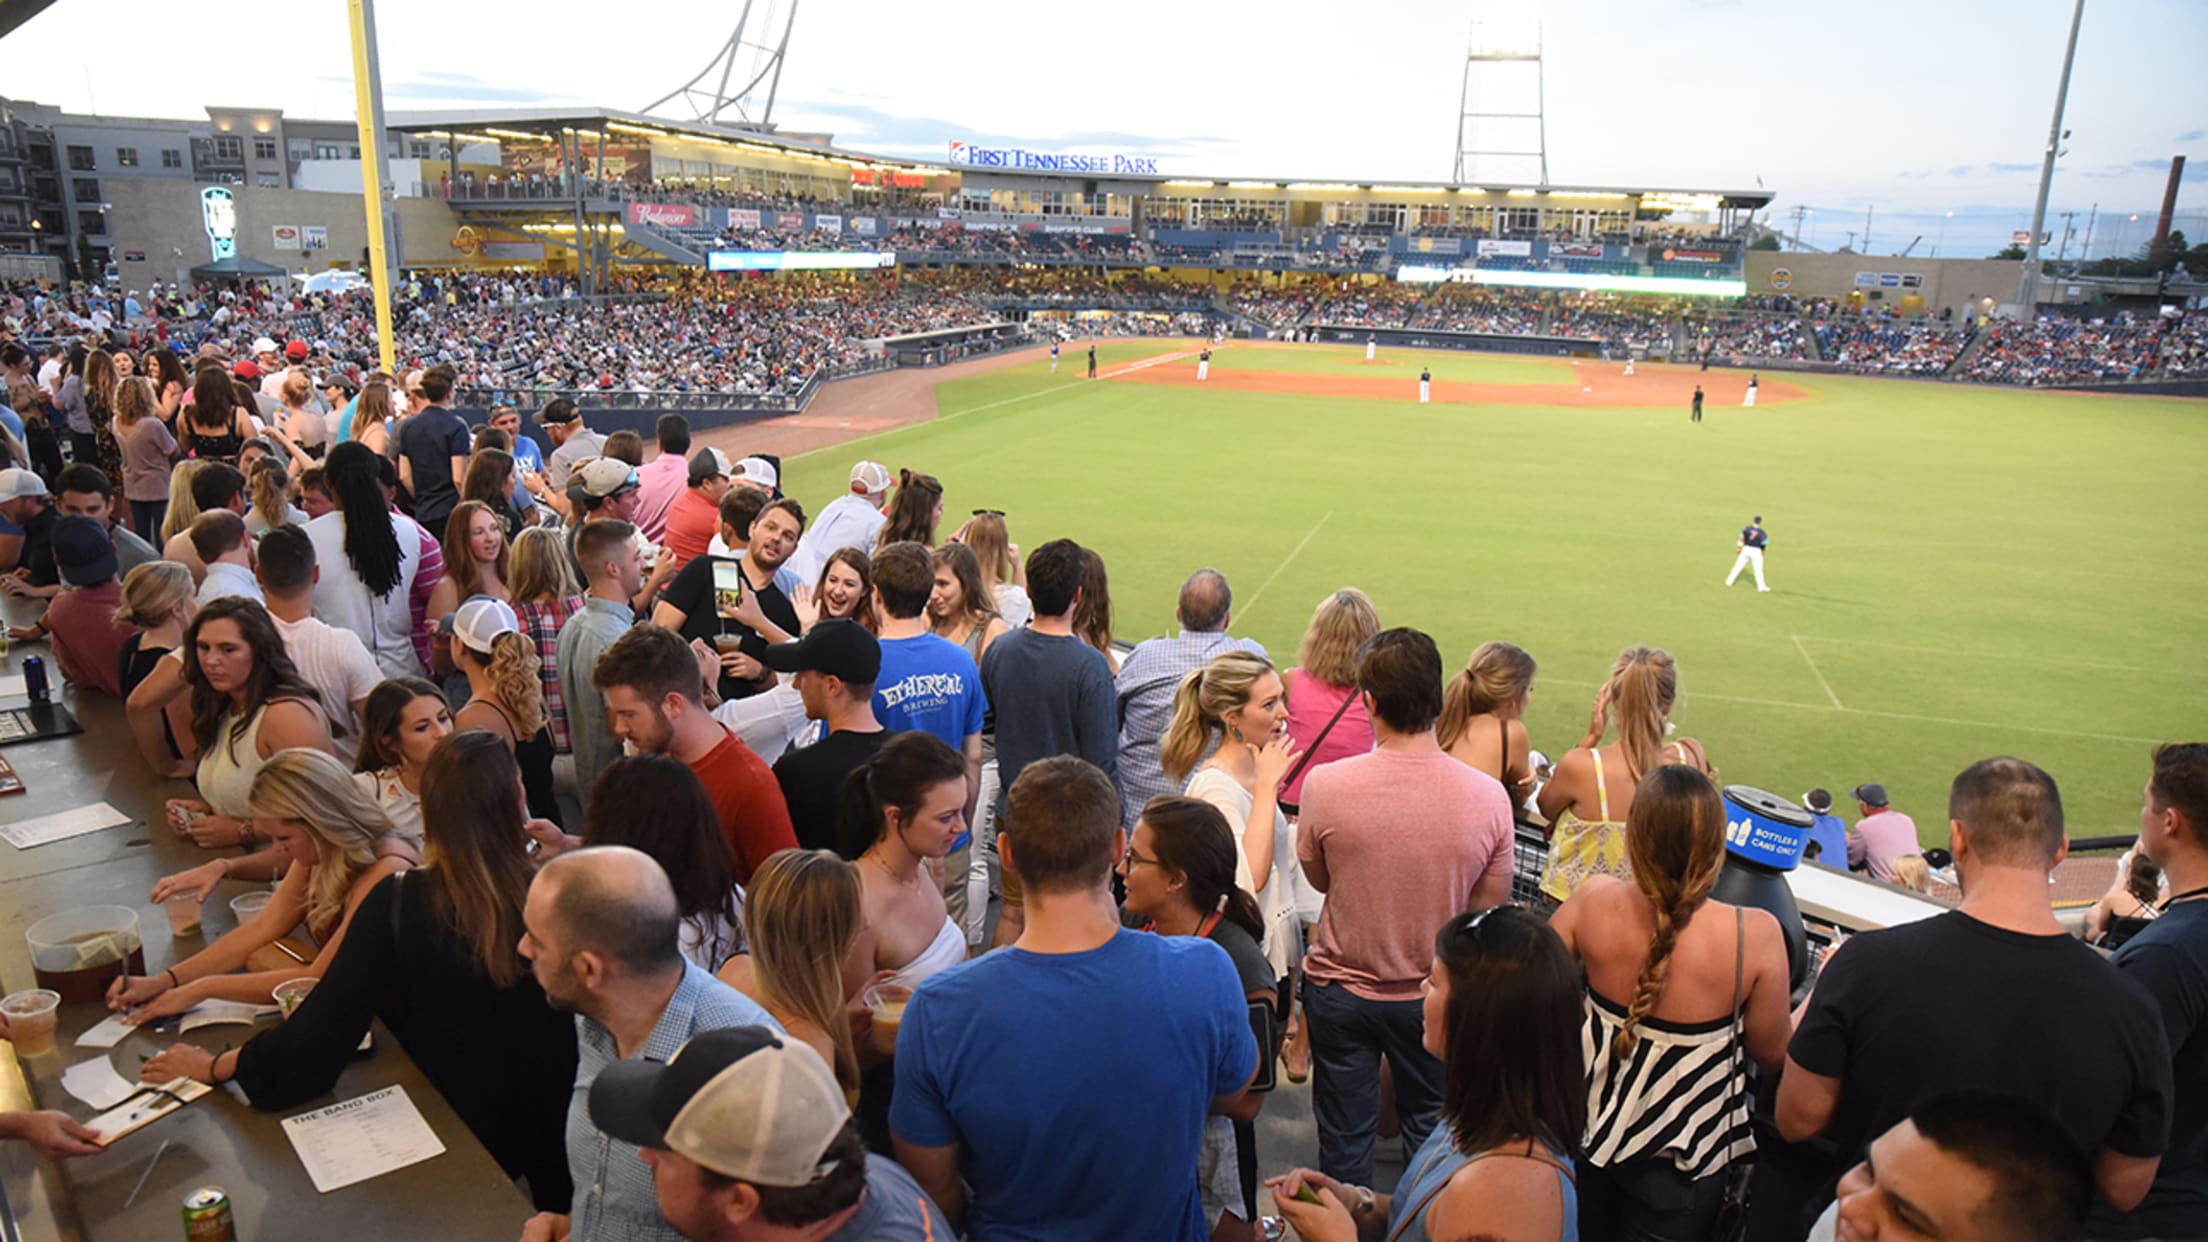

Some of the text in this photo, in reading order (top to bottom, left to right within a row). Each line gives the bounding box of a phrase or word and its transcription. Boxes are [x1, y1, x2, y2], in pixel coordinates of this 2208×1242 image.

[968, 145, 1159, 174] FIRST TENNESSEE PARK
[878, 672, 964, 709] ETHEREAL
[1751, 838, 1797, 856] CANS ONLY
[1755, 828, 1792, 845] BOTTLES
[292, 1088, 394, 1125] THE BAND BOX
